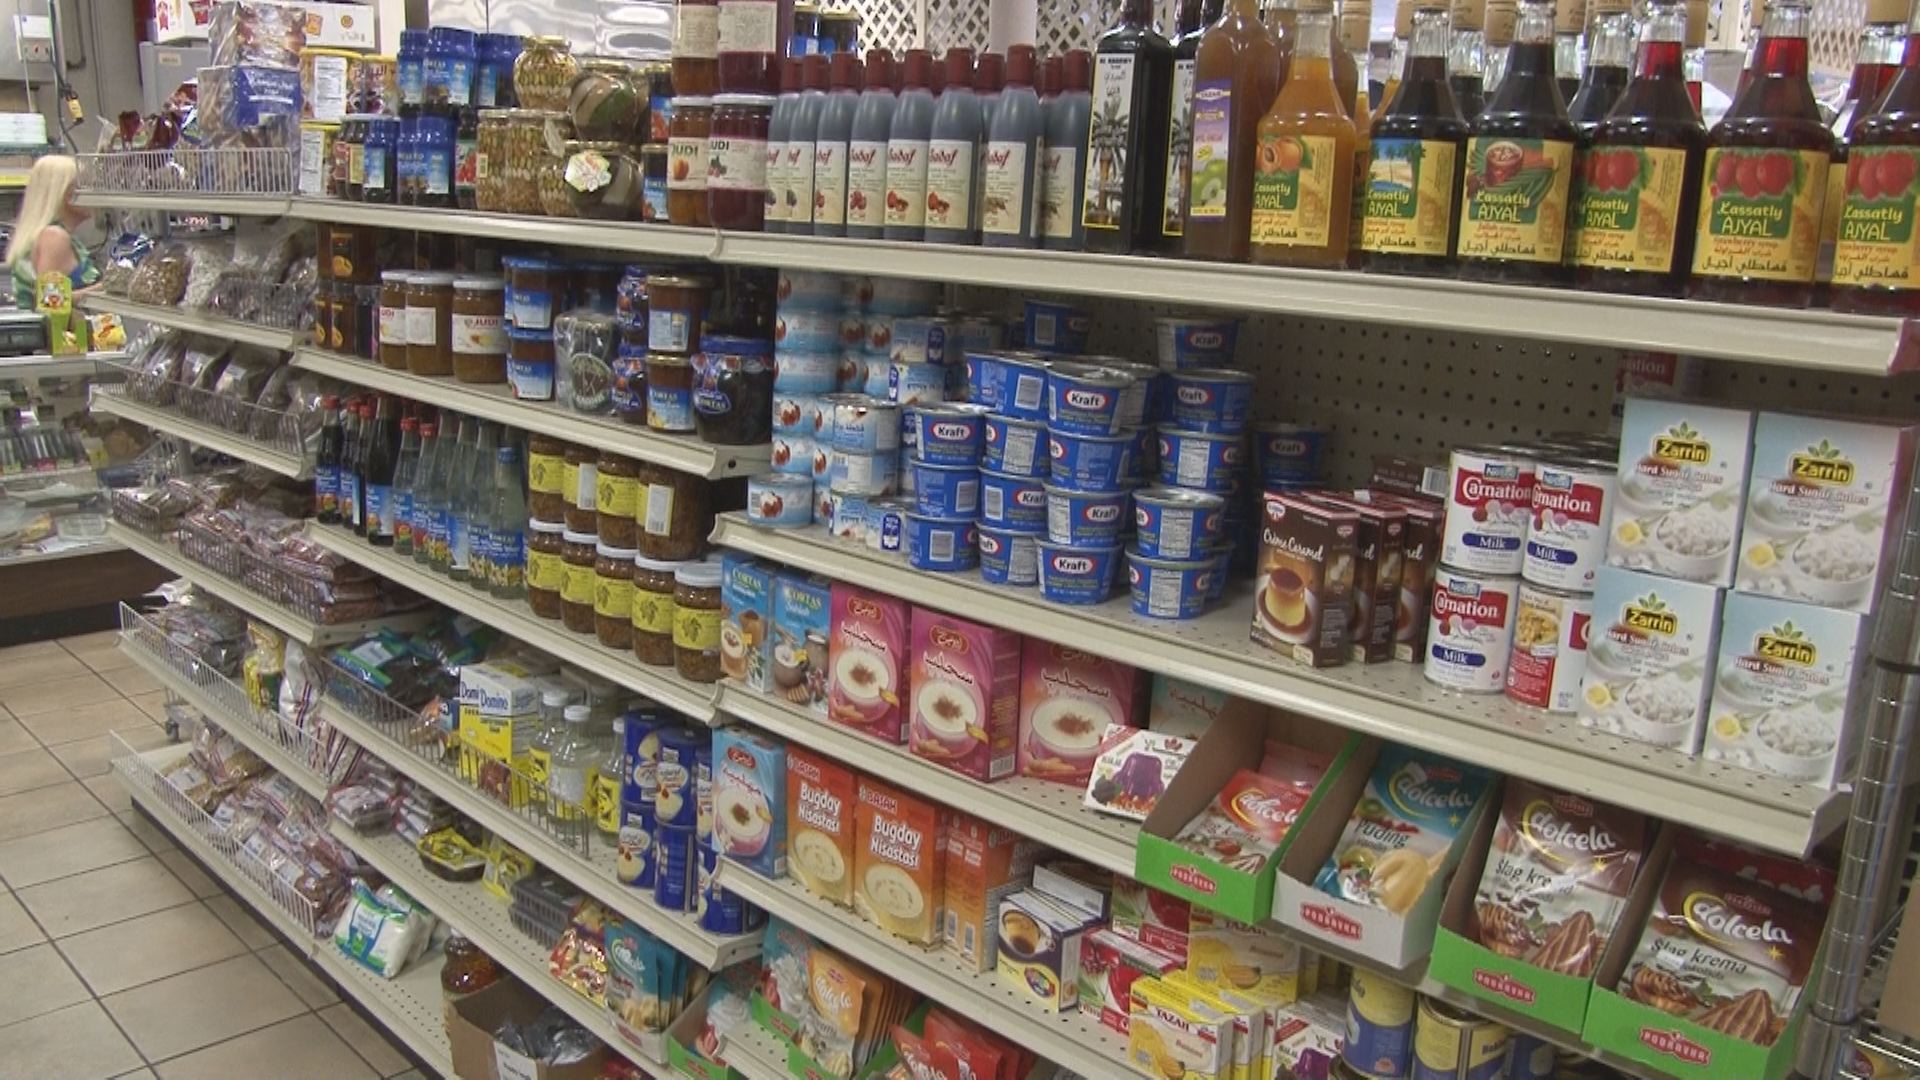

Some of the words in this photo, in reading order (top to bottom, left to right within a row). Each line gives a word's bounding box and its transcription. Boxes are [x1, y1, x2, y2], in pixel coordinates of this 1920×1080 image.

[1478, 203, 1521, 223] AJYAL
[1717, 200, 1783, 221] Kassatly
[1721, 216, 1773, 237] AJYAL
[1844, 220, 1890, 241] AJYAL
[1071, 394, 1100, 406] Kraft
[937, 426, 965, 437] Kraft
[1274, 442, 1301, 452] Kraft
[1657, 439, 1706, 462] Zarrin
[1795, 458, 1848, 483] Zarrin
[1092, 508, 1117, 519] Kraft
[1479, 536, 1507, 549] Milk
[1535, 547, 1559, 561] Milk
[1058, 558, 1087, 571] Kraft
[732, 567, 762, 592] CORTAS
[1627, 610, 1673, 633] Zarrin
[1442, 650, 1468, 664] Milk
[1758, 638, 1812, 664] Zarrin
[923, 650, 975, 686] سحلب
[1041, 667, 1112, 699] سحلب
[873, 814, 922, 850] Bugday
[1530, 810, 1617, 851] dolcela
[1692, 901, 1793, 945] dolcela
[1690, 948, 1748, 975] krema
[1155, 1007, 1190, 1032] TAZAH
[1643, 1029, 1708, 1063] PODRAVKA
